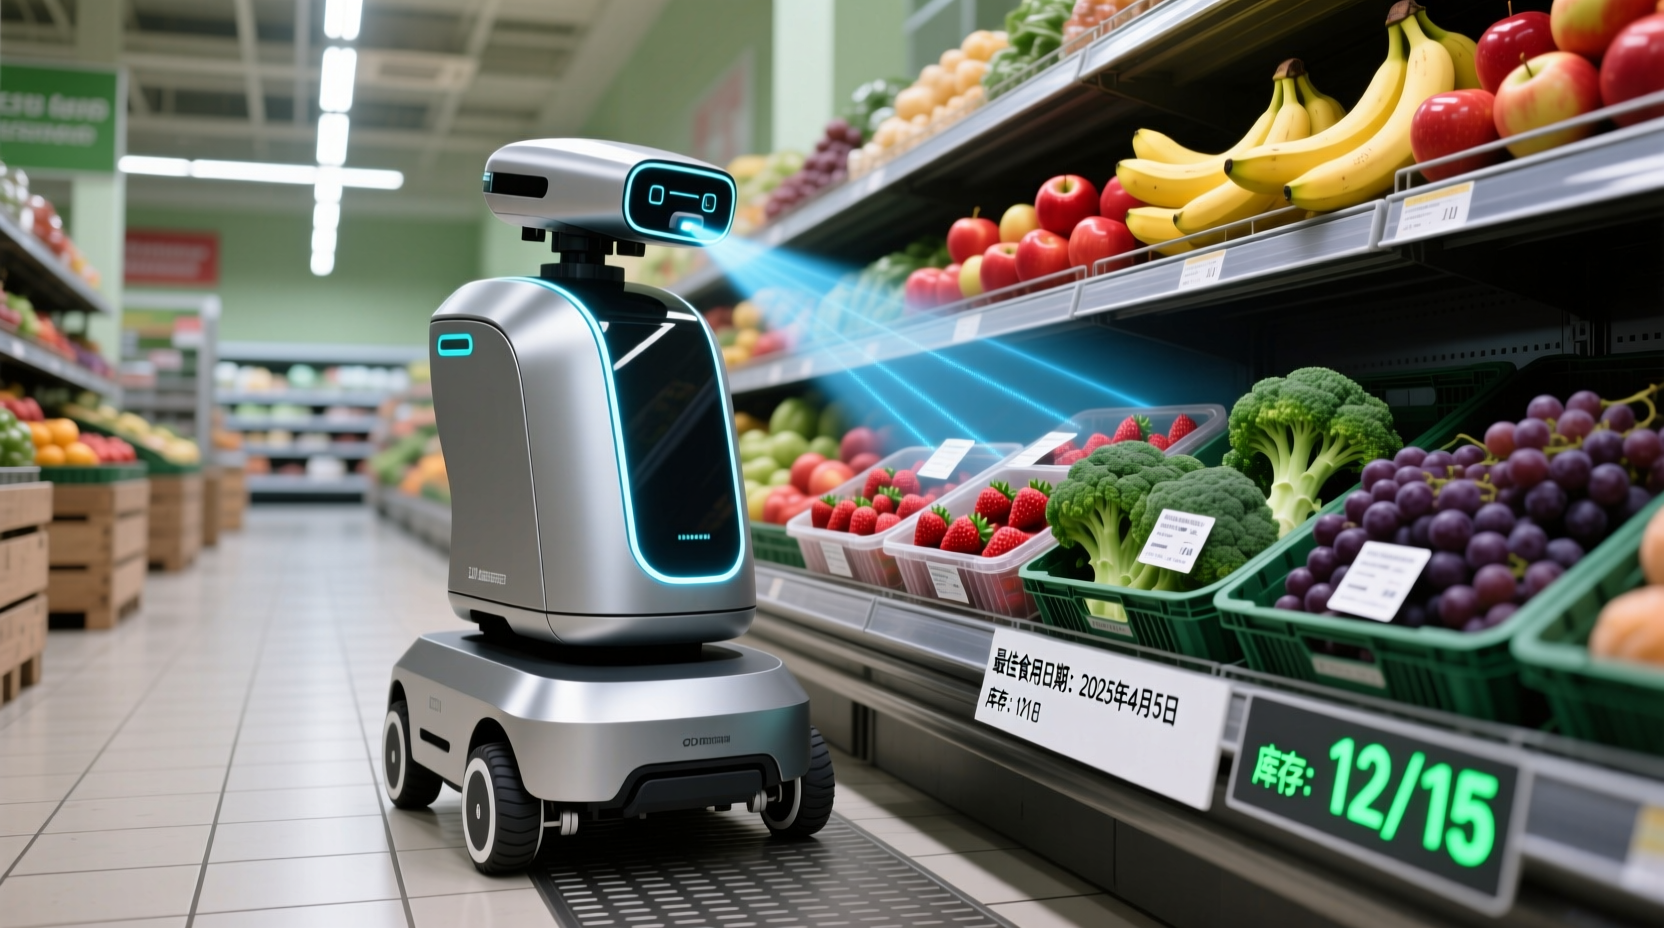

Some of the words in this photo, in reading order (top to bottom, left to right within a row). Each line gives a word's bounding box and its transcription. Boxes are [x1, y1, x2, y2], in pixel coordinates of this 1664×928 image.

[1079, 674, 1179, 727] 2025年4月5日
[1251, 743, 1315, 797] 库存：
[1328, 736, 1500, 868] 12/15
